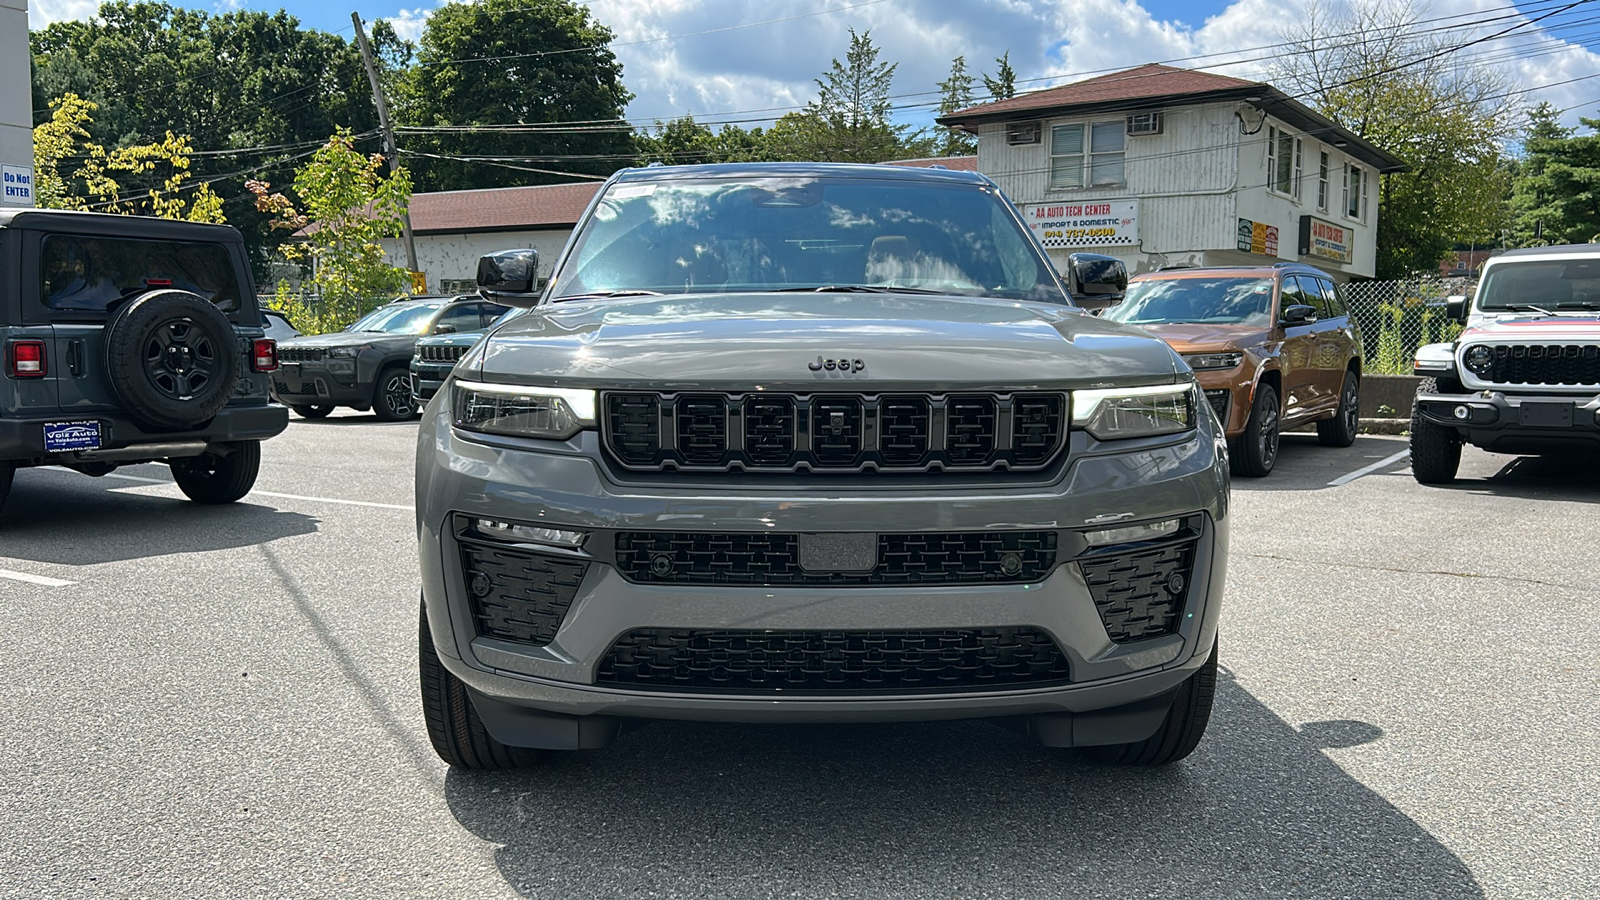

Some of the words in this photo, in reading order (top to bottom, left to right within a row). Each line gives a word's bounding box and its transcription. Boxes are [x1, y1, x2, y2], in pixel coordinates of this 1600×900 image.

[4, 172, 14, 182] Do
[16, 174, 30, 184] Not
[6, 186, 29, 197] ENTER
[1036, 208, 1046, 218] AA
[1047, 206, 1064, 218] AUTO
[1065, 205, 1083, 217] TECH
[1084, 204, 1111, 216] CENTER
[1079, 218, 1120, 226] DOMESTIC
[808, 355, 865, 374] Jeep
